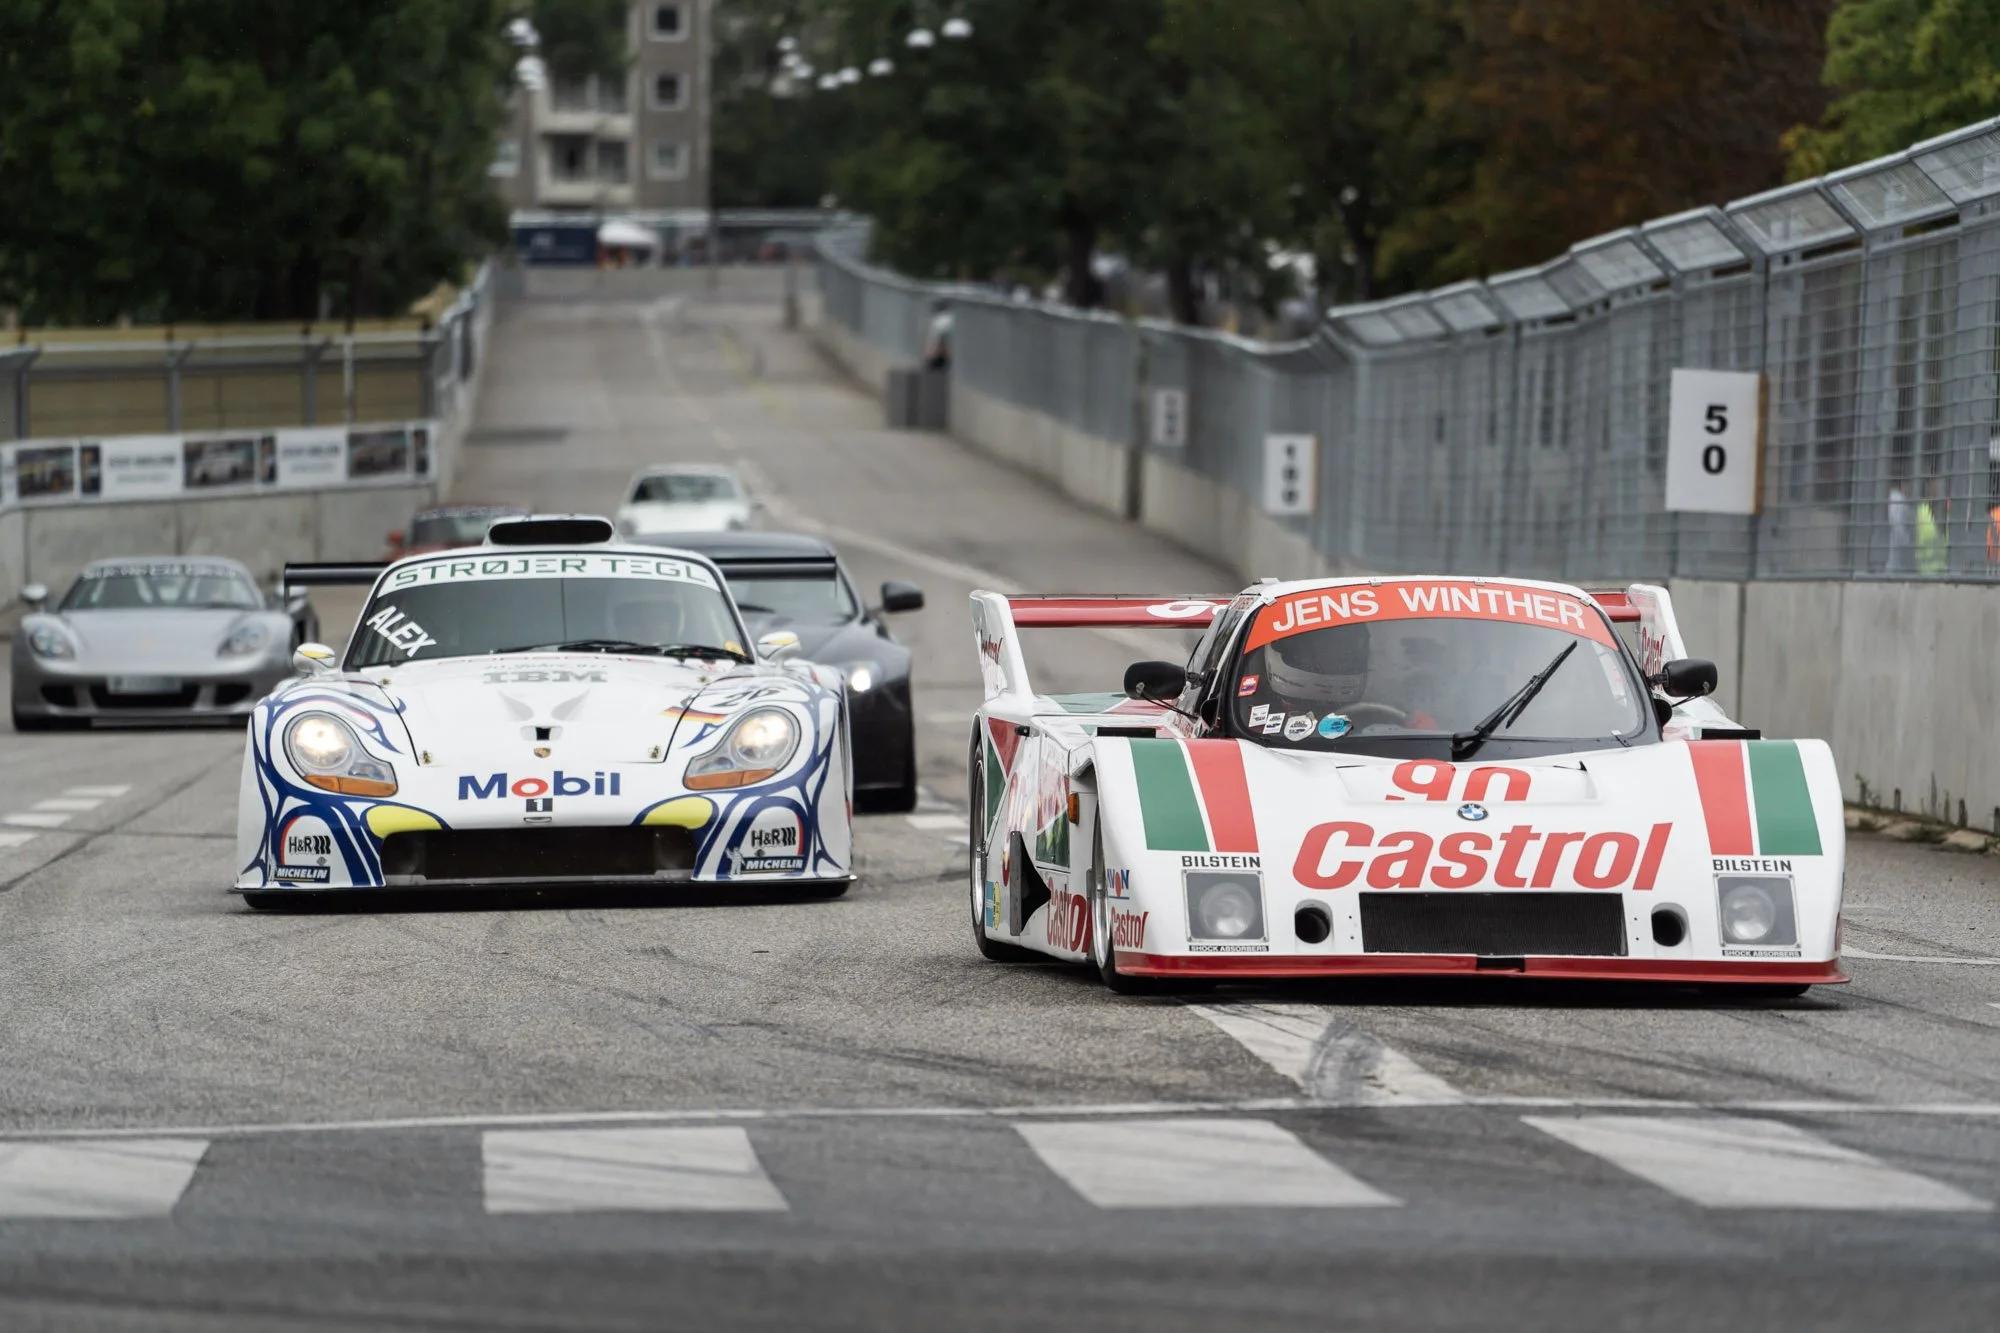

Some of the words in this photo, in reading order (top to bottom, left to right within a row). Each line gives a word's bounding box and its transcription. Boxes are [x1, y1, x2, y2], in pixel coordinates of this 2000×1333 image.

[1702, 404, 1728, 475] 50
[395, 558, 587, 587] STRØJER
[601, 558, 708, 583] TEGL
[1272, 590, 1379, 632] JENS
[1397, 586, 1586, 630] WINTHER
[366, 605, 437, 658] ALEX
[483, 671, 608, 684] IBM
[458, 771, 620, 800] Mobil
[289, 836, 312, 854] H&R
[751, 828, 780, 847] H&R
[745, 858, 803, 870] MICHELIN
[1181, 856, 1261, 868] BILSTEIN
[1292, 821, 1673, 890] Castrol
[1712, 859, 1792, 872] BILSTEIN
[276, 868, 328, 879] MICHELIN
[1111, 906, 1149, 949] Castrol
